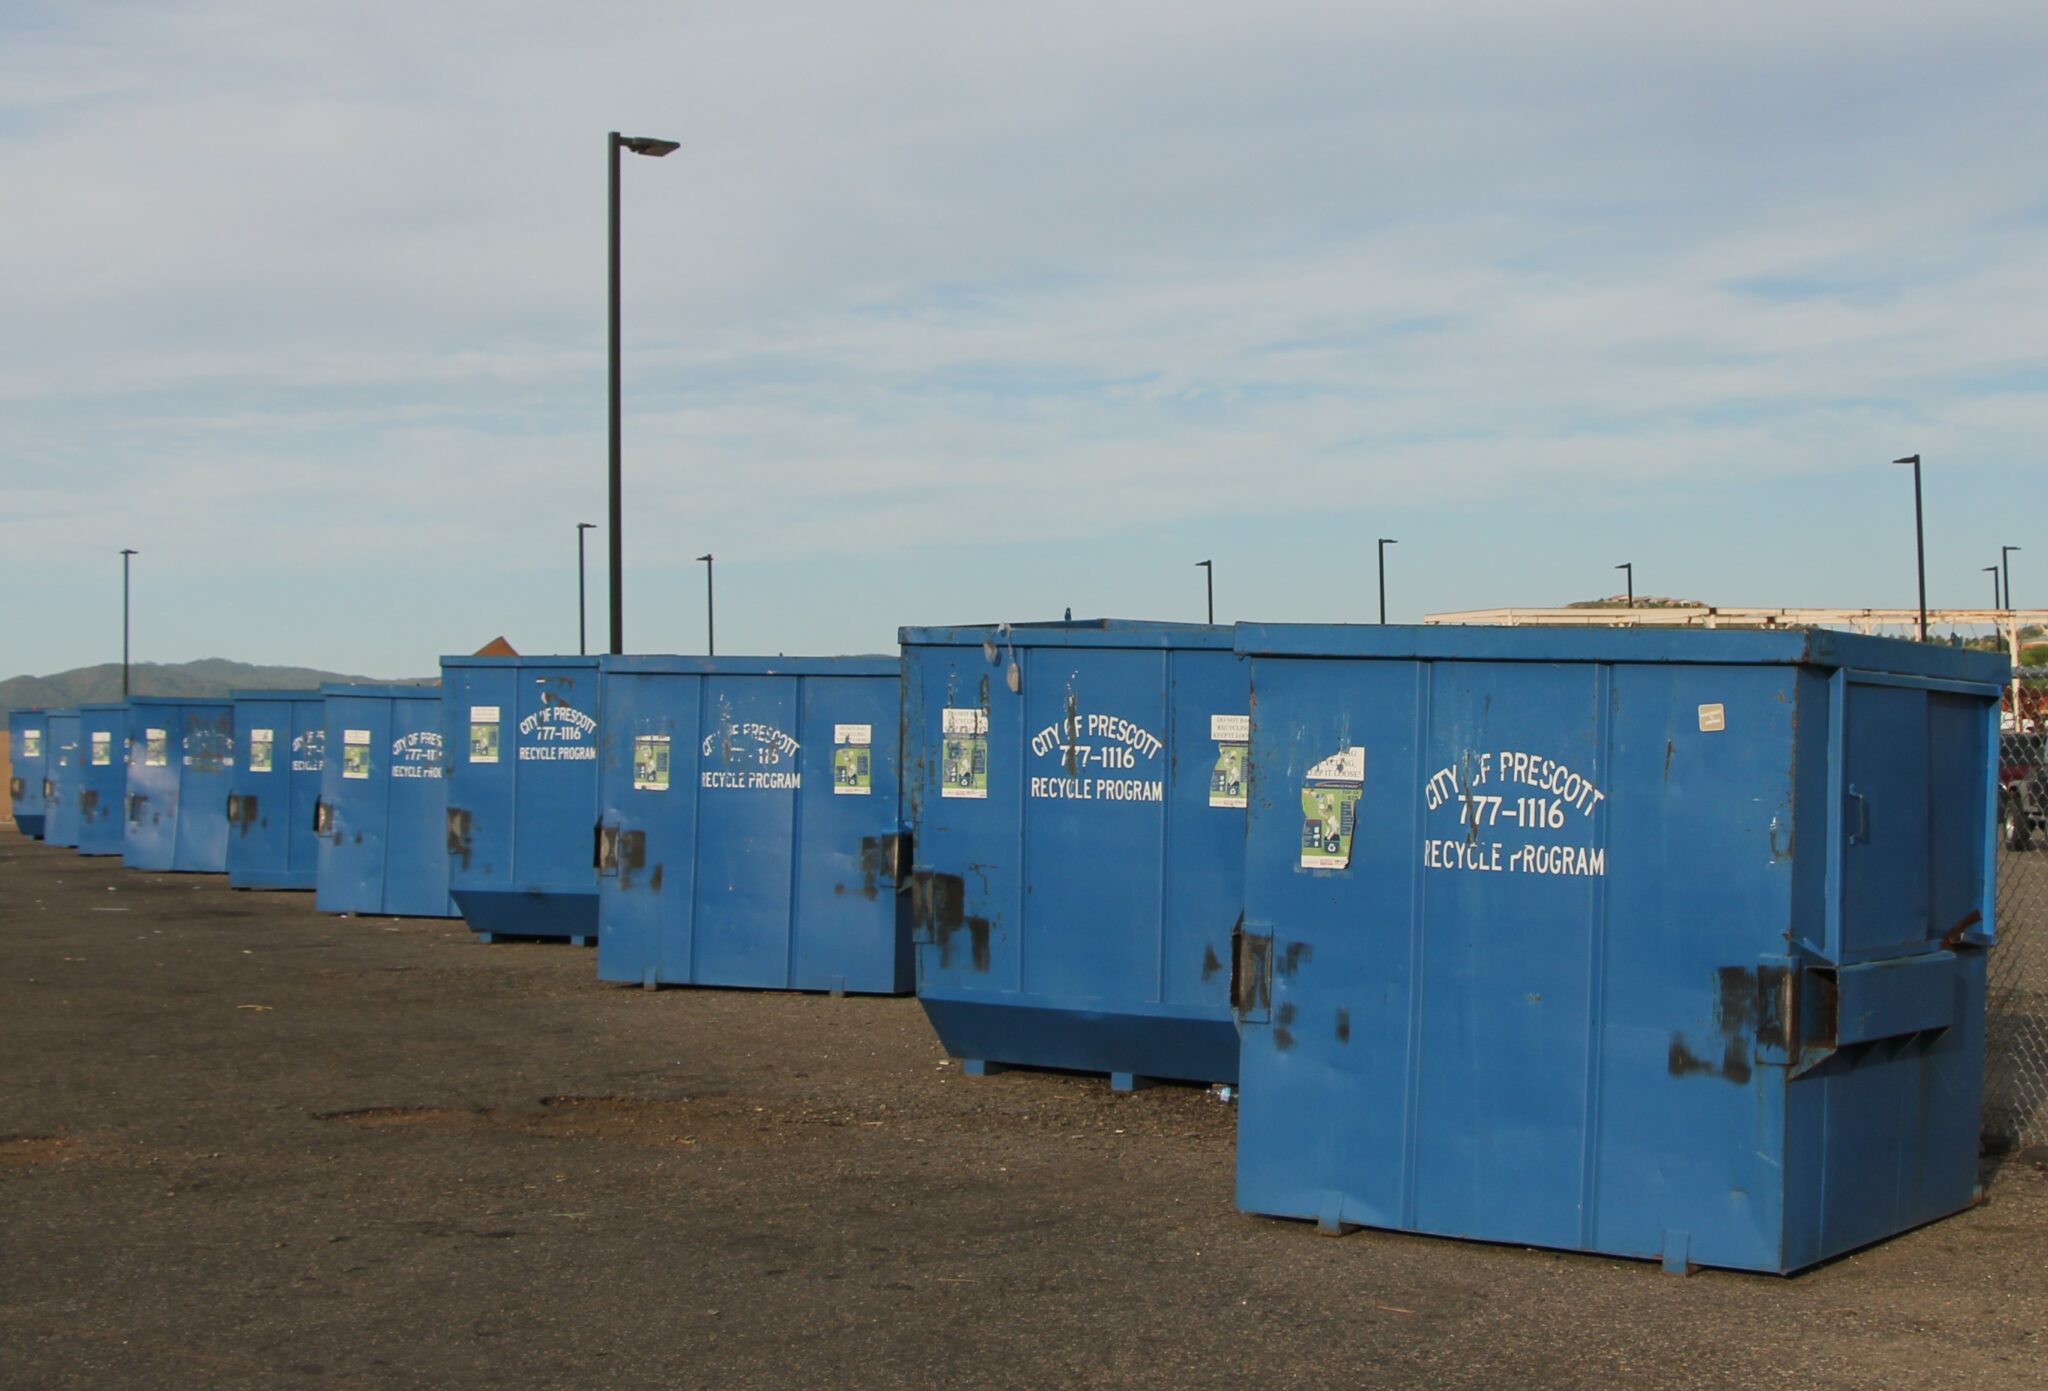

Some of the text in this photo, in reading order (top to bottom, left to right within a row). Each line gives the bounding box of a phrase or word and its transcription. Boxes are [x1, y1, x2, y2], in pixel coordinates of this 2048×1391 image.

[519, 713, 538, 735] CITY
[553, 706, 597, 734] PRESCOTT
[1032, 723, 1060, 757] CITY
[1088, 714, 1163, 760] PRESCOTT
[519, 746, 597, 760] RECYCLE PROGRAM
[1031, 777, 1163, 801] RECYCLE PROGRAM
[1425, 764, 1459, 811] CITY
[1499, 751, 1605, 817] PRESCOTT
[1458, 795, 1565, 829] 777-1116
[1424, 840, 1502, 871] RECYCLE
